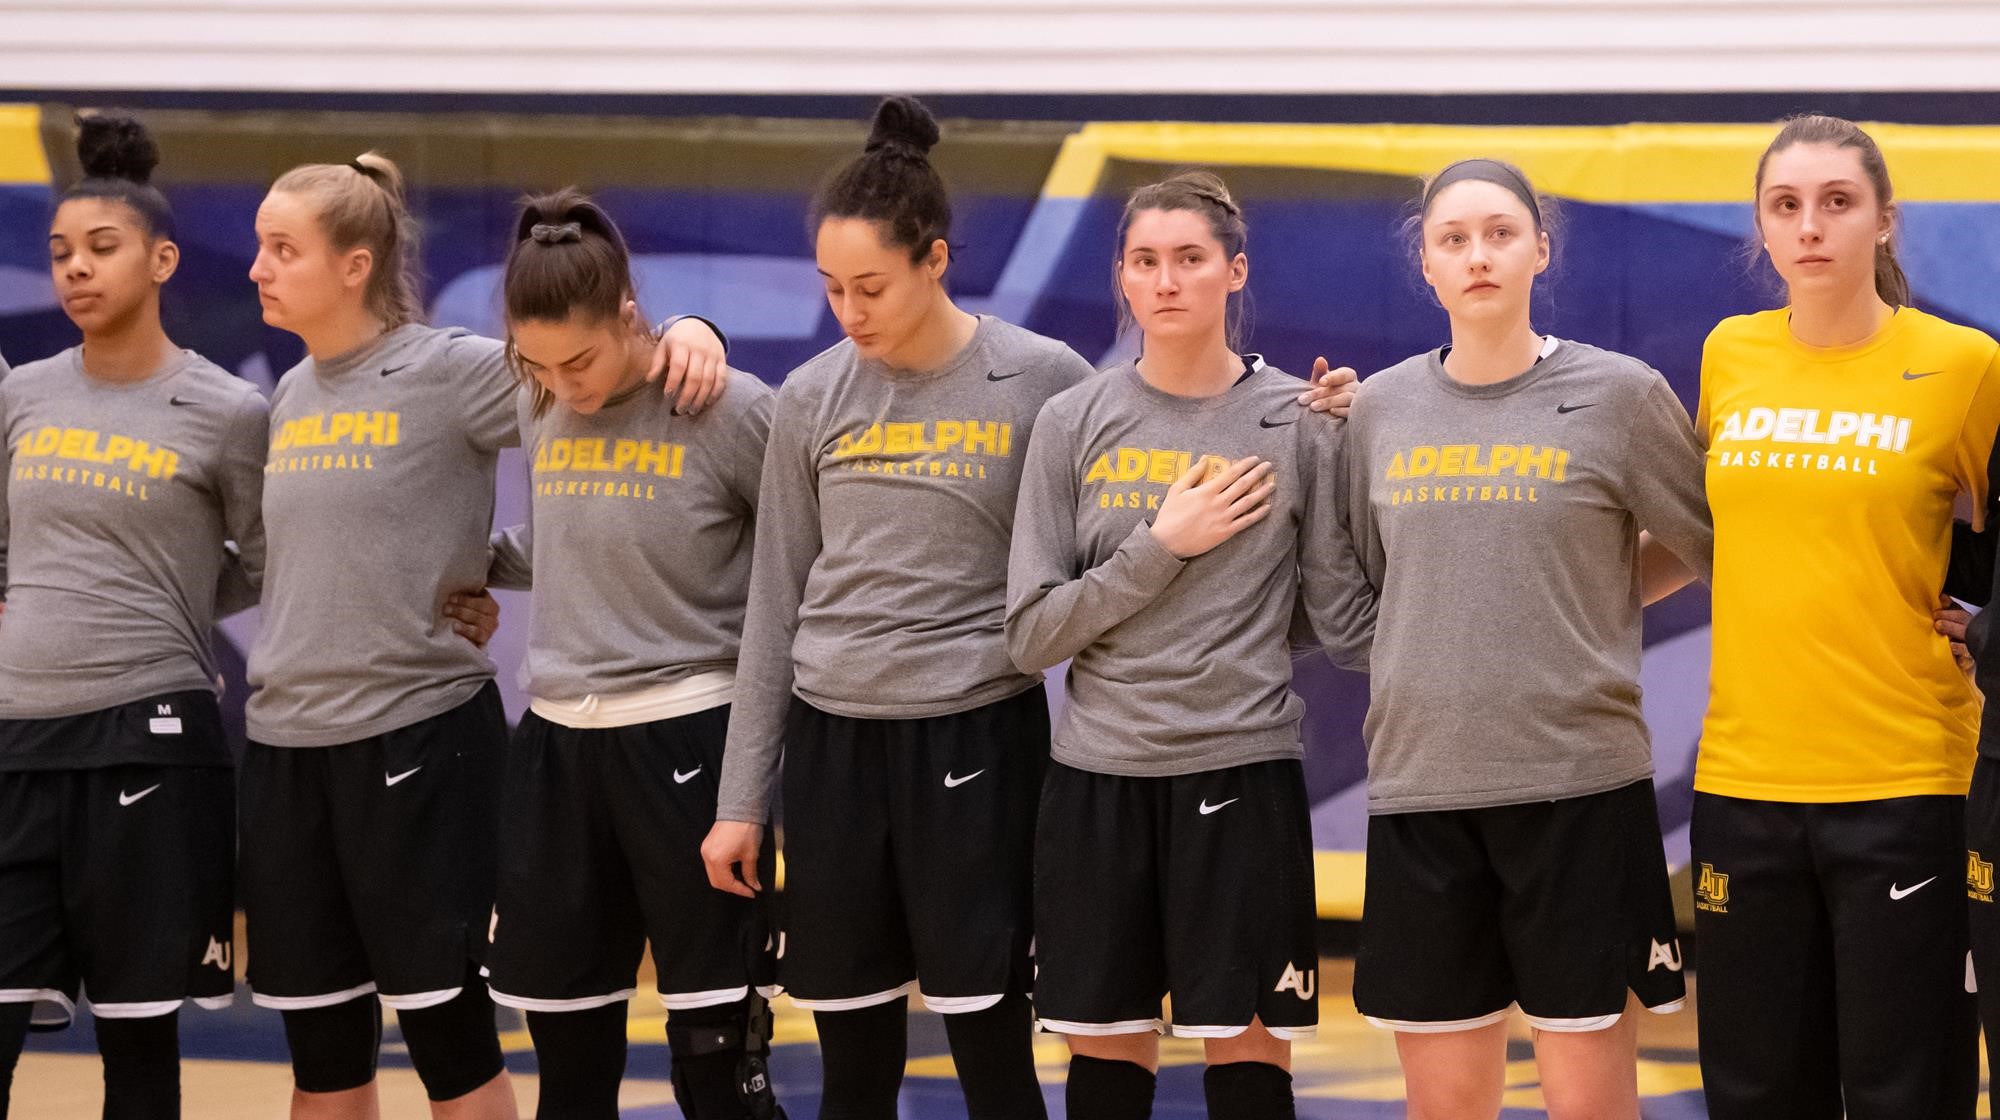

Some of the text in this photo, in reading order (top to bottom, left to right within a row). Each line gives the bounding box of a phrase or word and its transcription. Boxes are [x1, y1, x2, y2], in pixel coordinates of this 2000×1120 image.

[832, 420, 1012, 457] ADELPHI
[1718, 407, 1911, 454] ADELPHI
[16, 426, 179, 479] ADELPHI
[265, 454, 374, 473] SKETBALL
[534, 437, 685, 479] ADELPHI
[1386, 444, 1570, 482] ADELPHI
[1719, 450, 1878, 475] BASKETBALL
[536, 480, 655, 500] BASKETBALL
[1392, 486, 1538, 506] BASKETBALL
[157, 703, 172, 715] M
[1696, 862, 1730, 905] AU
[201, 934, 231, 971] AU
[1647, 936, 1683, 972] AU
[1273, 960, 1315, 1001] AU
